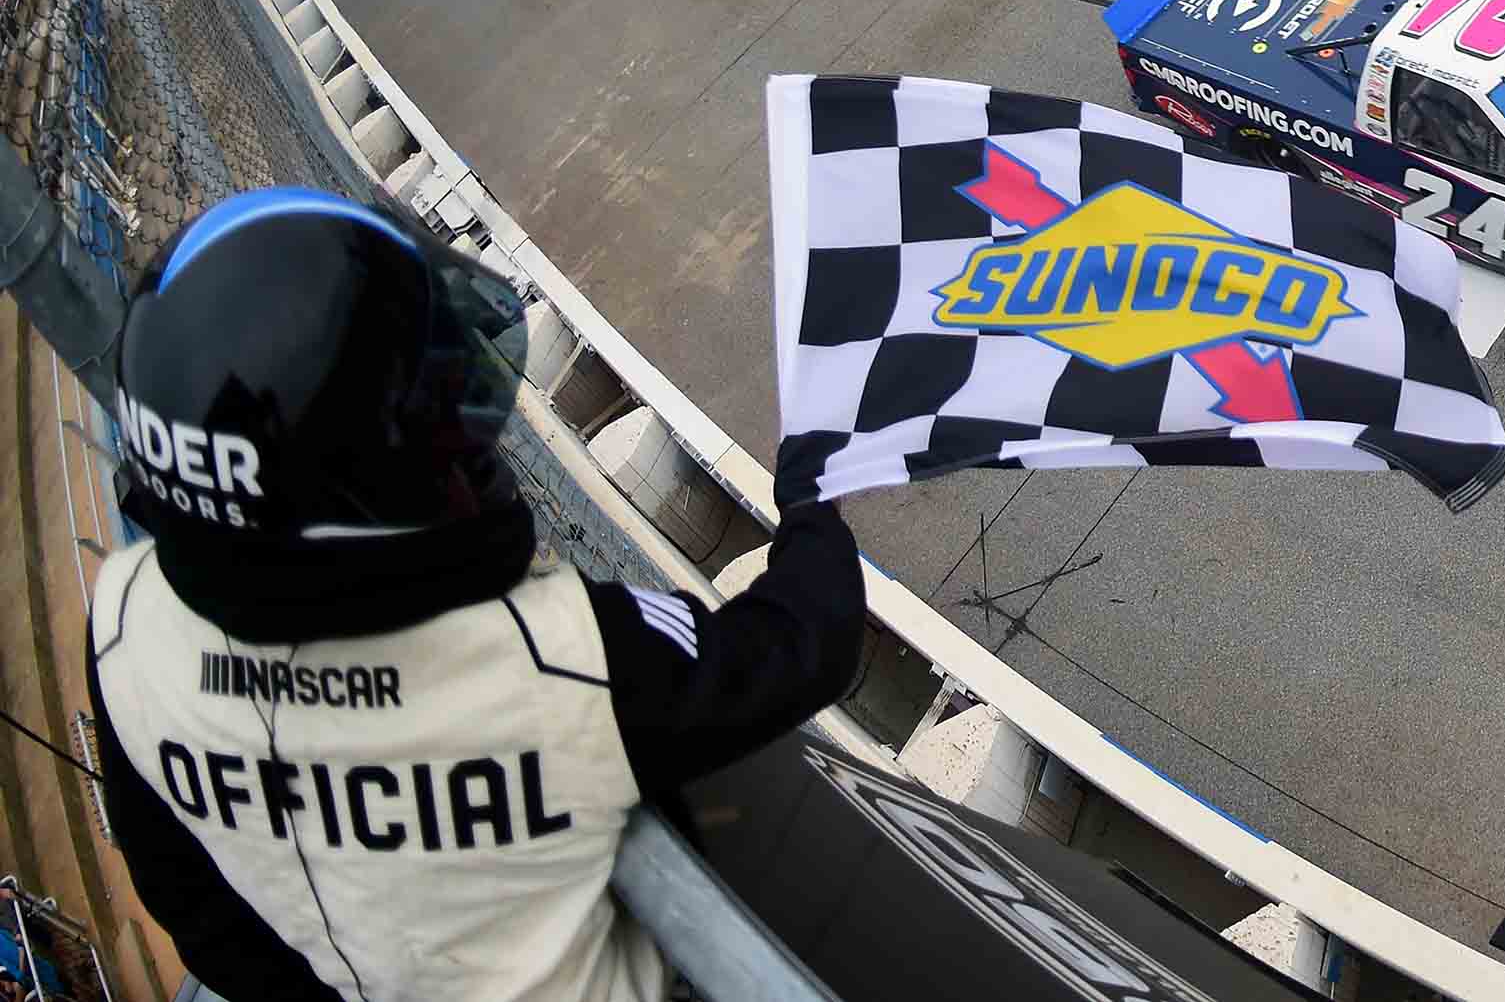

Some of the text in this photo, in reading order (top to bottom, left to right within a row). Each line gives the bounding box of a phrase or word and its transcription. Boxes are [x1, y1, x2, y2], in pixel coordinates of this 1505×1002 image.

[950, 241, 1325, 331] SUNOCO
[118, 386, 265, 497] NDER
[138, 463, 246, 527] OORS
[245, 656, 401, 708] NASCAR
[158, 736, 572, 852] OFFICIAL
